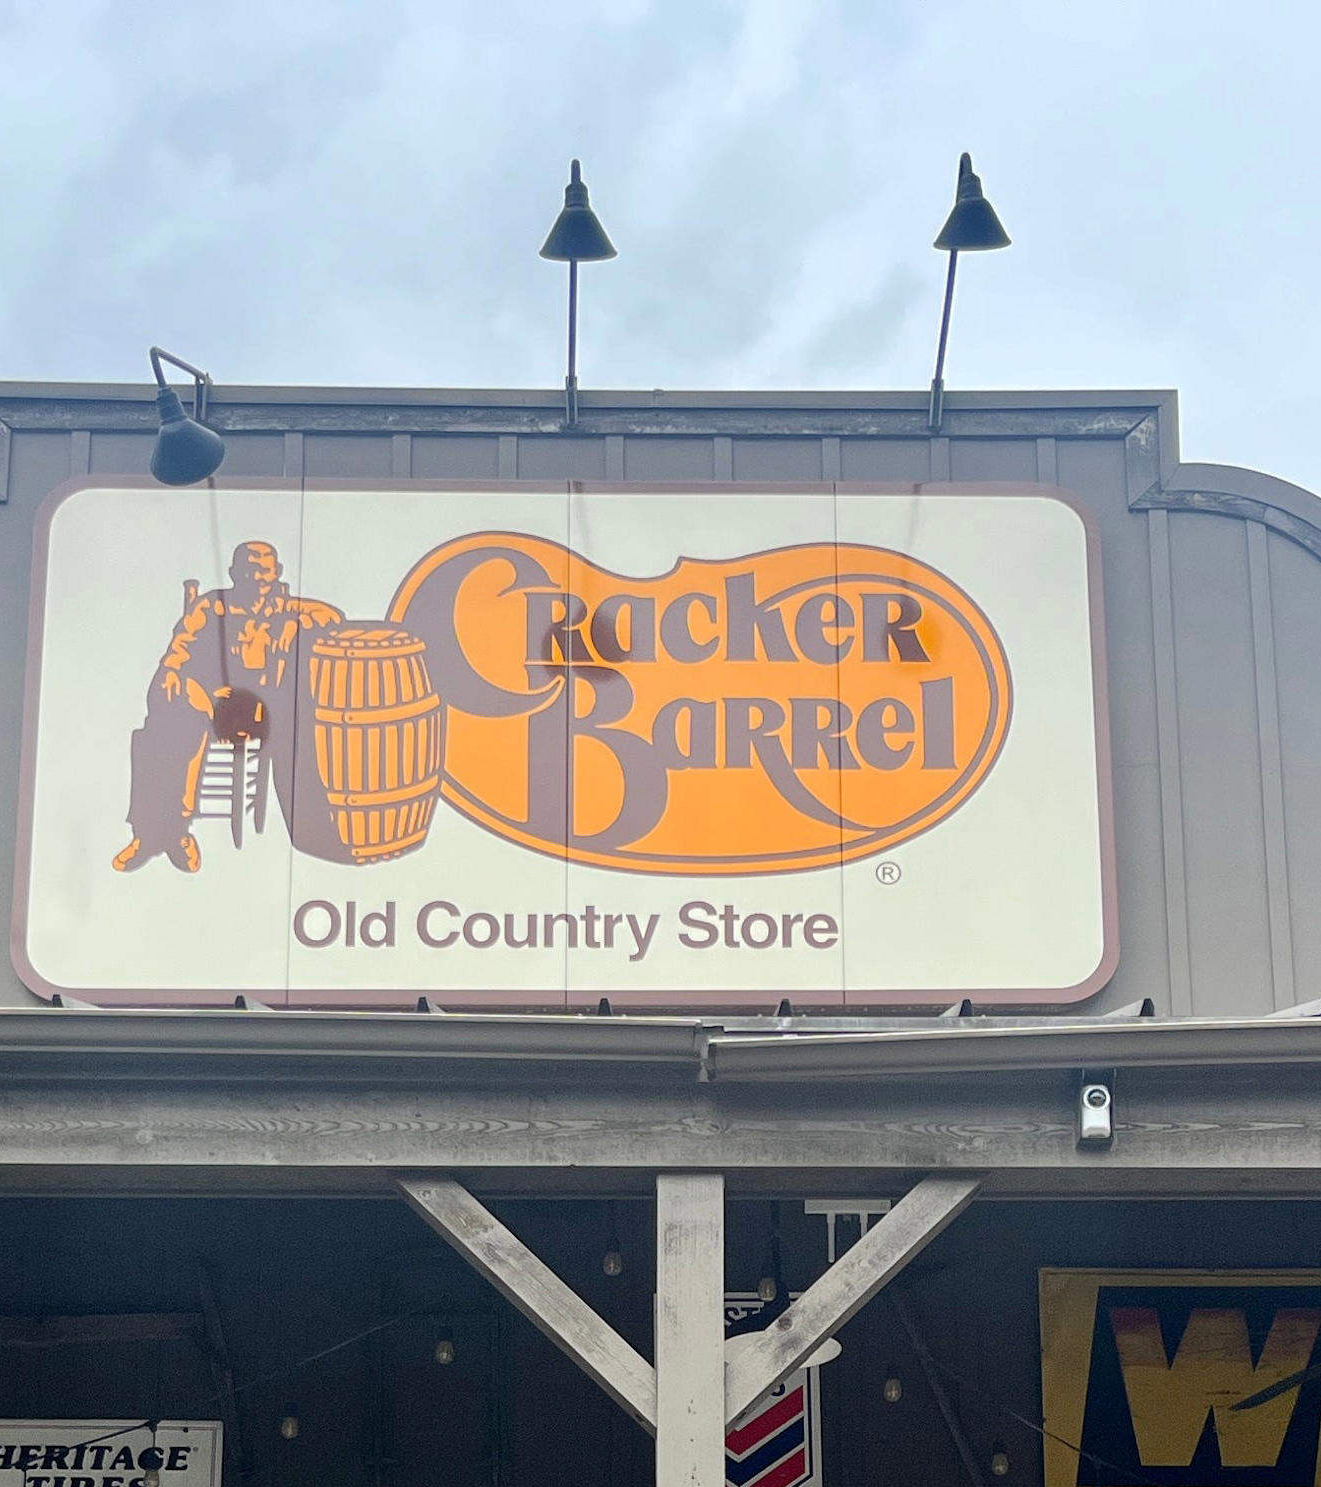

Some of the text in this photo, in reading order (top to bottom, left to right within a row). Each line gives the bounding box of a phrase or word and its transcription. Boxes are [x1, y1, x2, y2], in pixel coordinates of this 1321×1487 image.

[293, 899, 838, 961] Old Country Store
